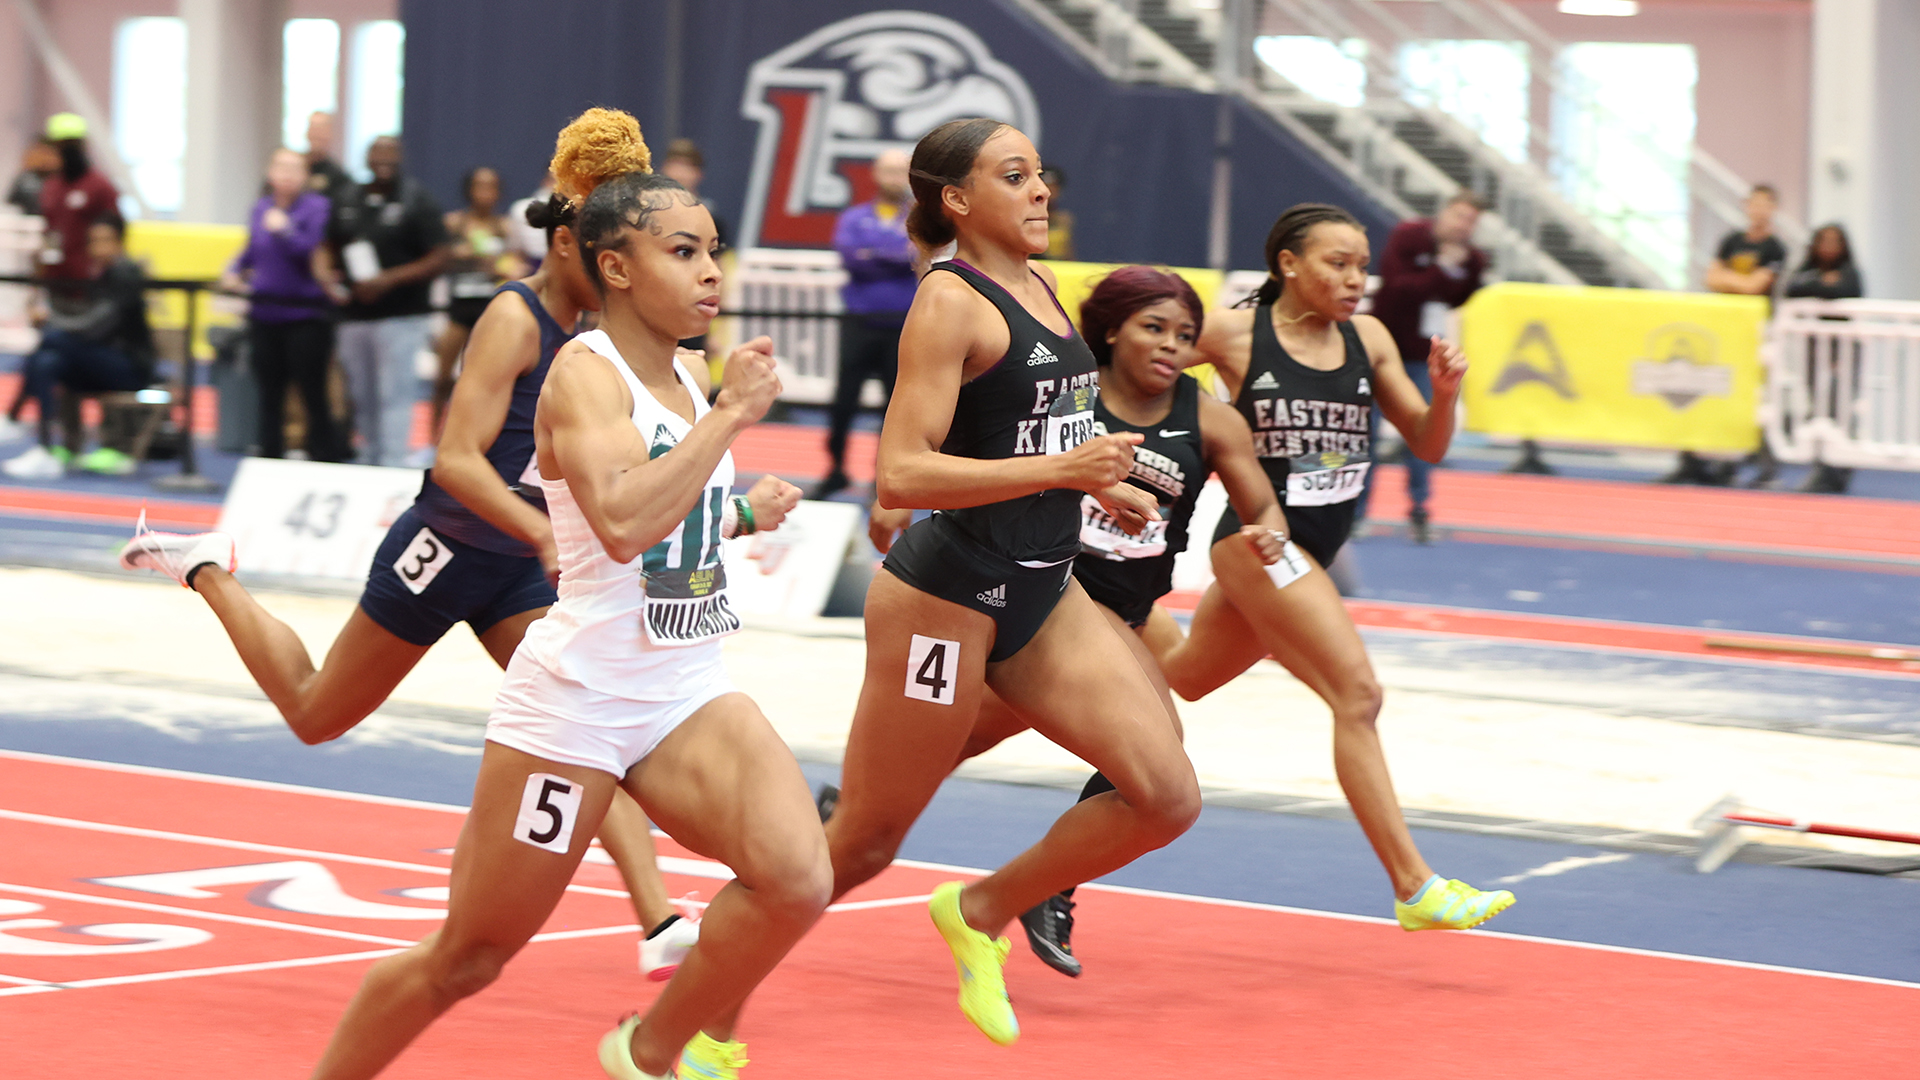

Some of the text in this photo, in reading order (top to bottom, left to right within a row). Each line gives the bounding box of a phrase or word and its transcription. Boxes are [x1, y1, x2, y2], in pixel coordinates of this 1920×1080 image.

[284, 492, 348, 538] 43
[402, 538, 438, 581] 3
[648, 594, 740, 640] WILLIAMS
[976, 592, 1007, 608] adidas
[915, 643, 947, 699] 4
[528, 779, 571, 844] 5
